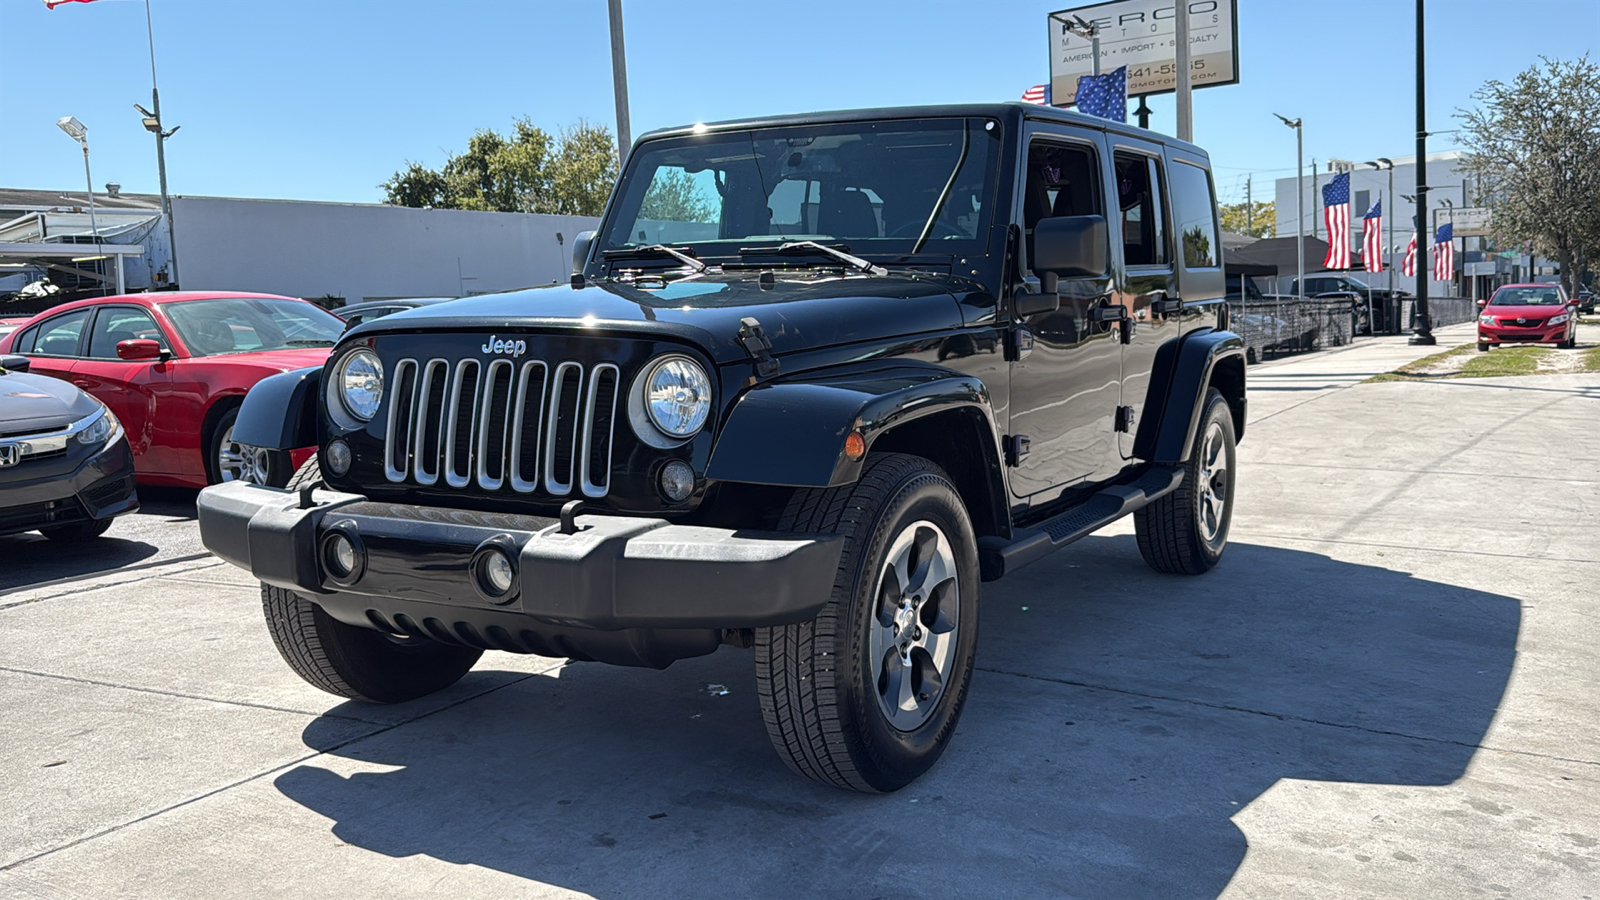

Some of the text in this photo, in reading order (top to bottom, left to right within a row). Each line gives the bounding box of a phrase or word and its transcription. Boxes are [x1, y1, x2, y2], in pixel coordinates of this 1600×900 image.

[1063, 33, 1219, 63] AMERICN IMPORT SIALTY
[1127, 59, 1205, 80] 41-55
[481, 334, 527, 358] Jeep
